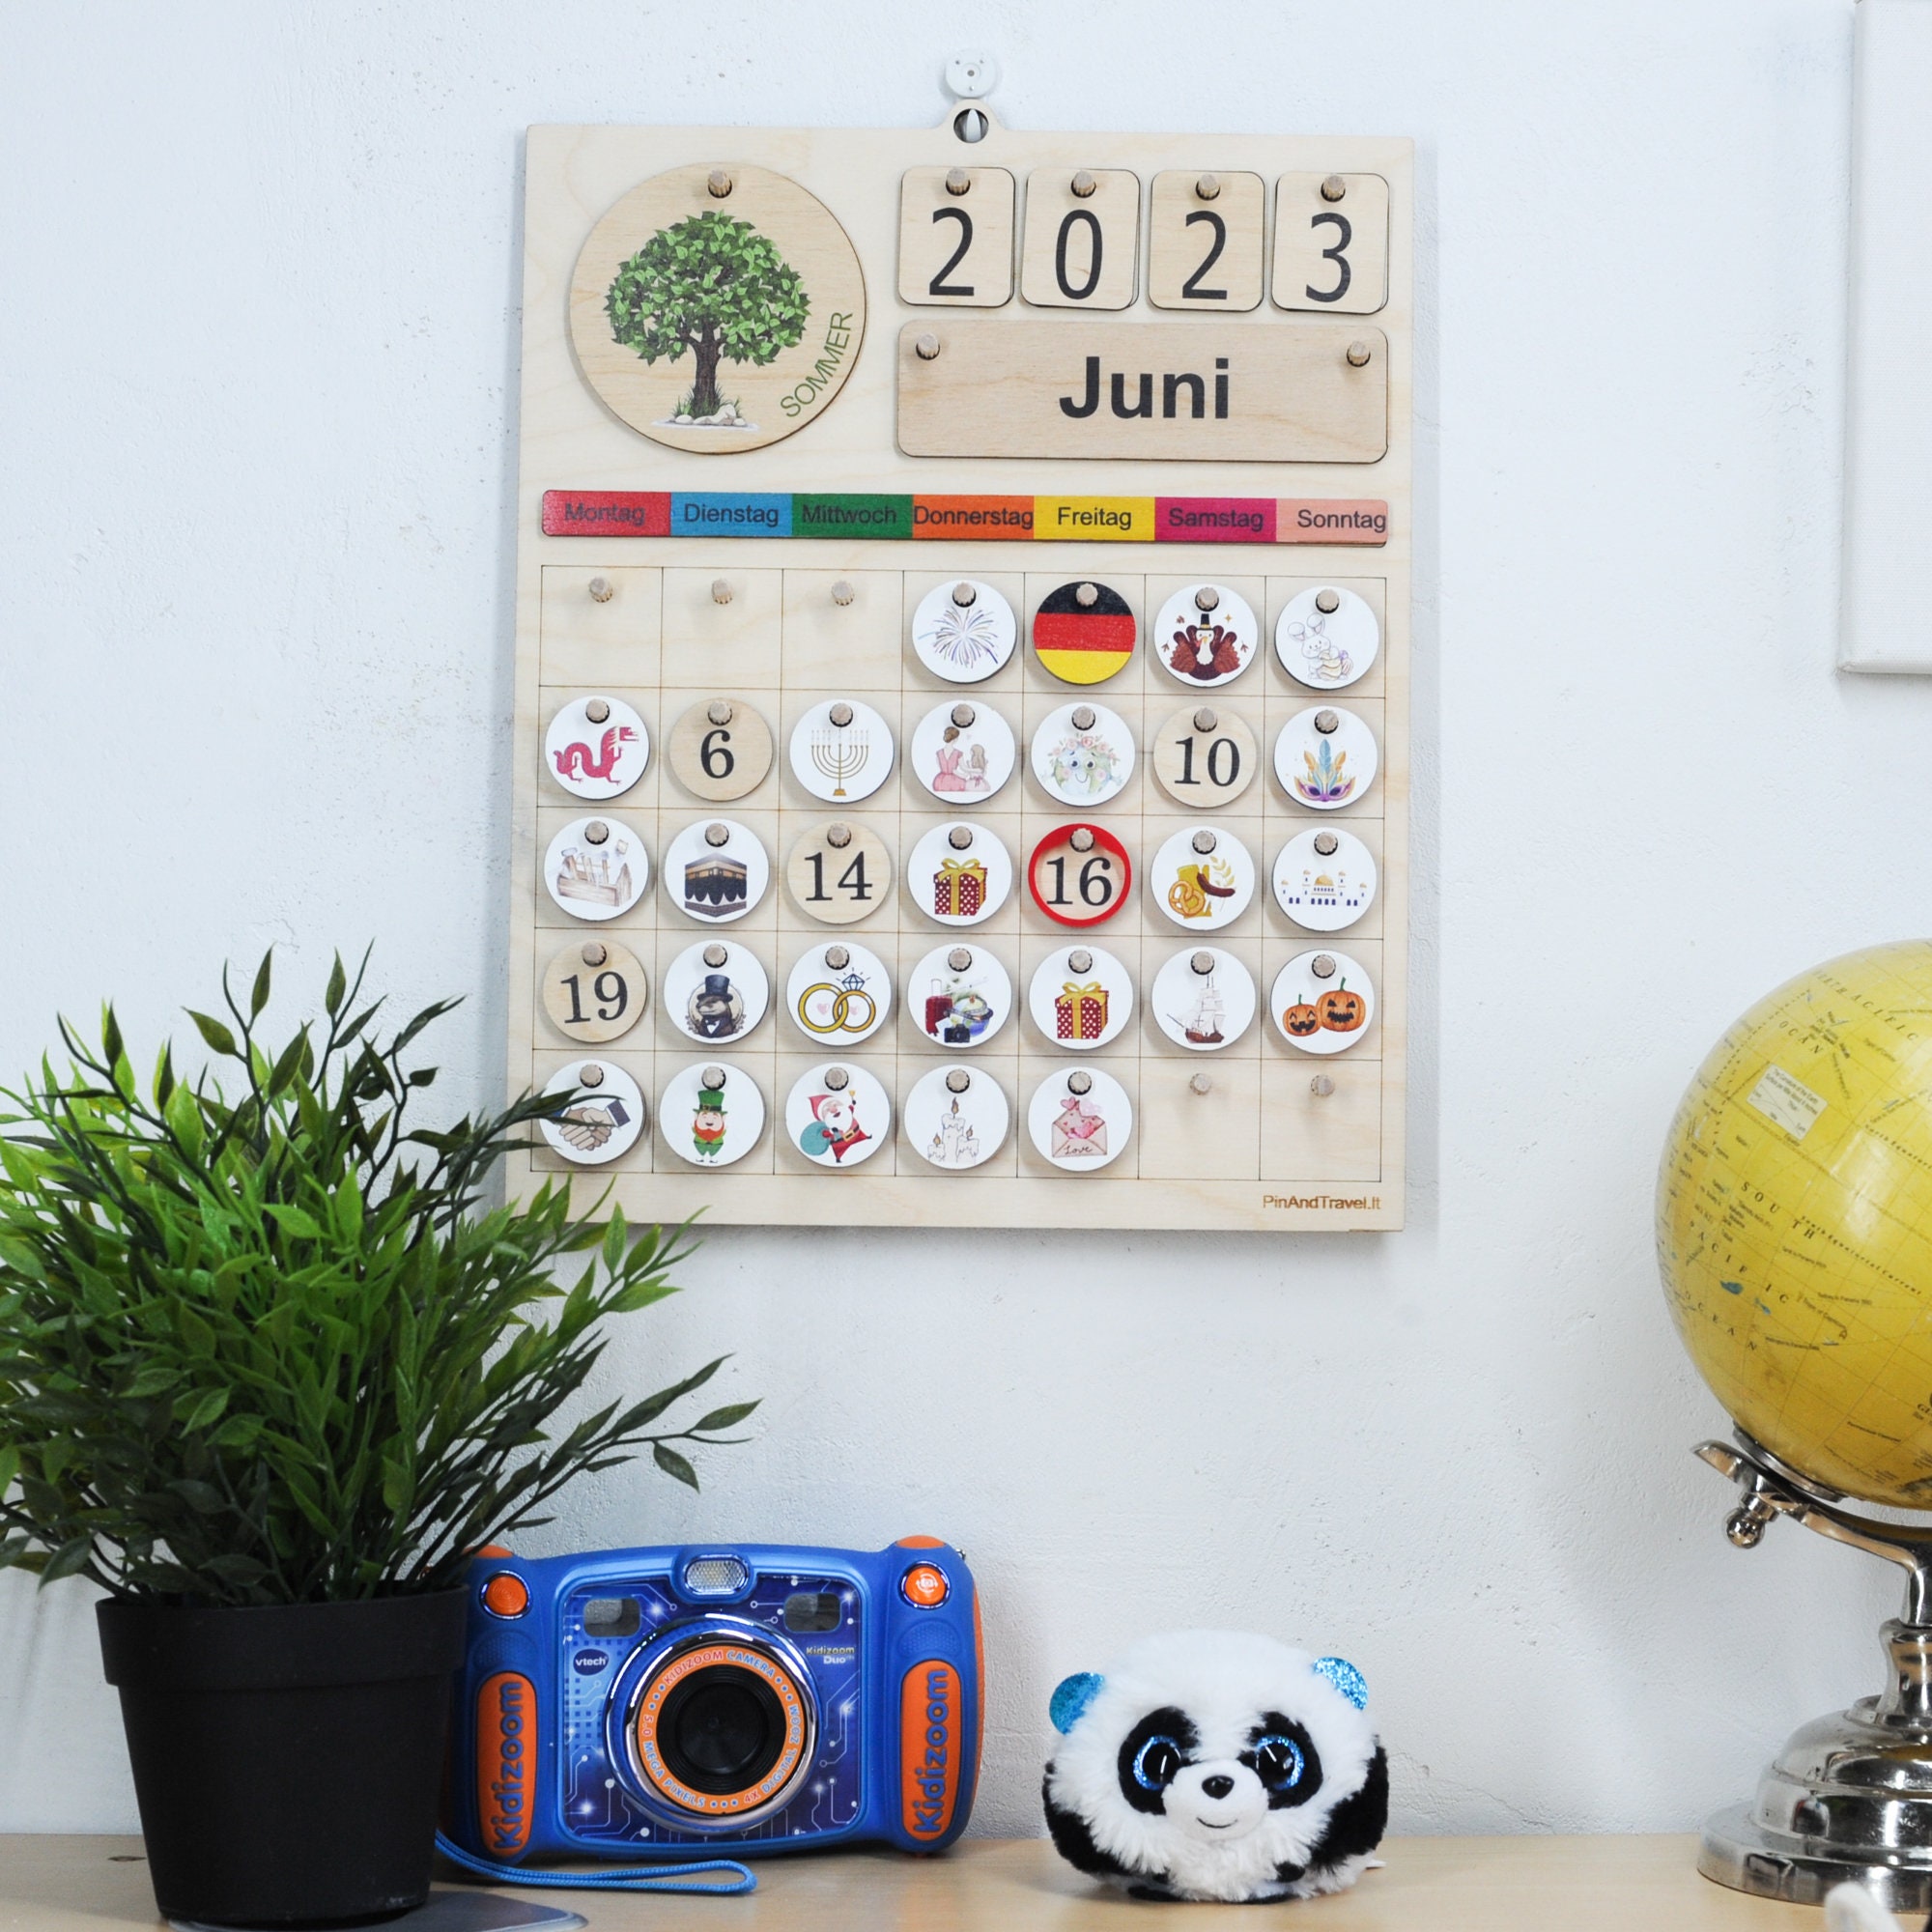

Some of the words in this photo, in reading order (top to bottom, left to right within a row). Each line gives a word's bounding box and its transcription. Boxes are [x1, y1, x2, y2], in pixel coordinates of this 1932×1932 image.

[780, 311, 854, 417] SOMMER
[1059, 355, 1230, 419] Juni
[564, 501, 646, 526] Montag
[684, 502, 780, 527] Dienstag
[802, 502, 897, 525] Mittwoch
[914, 504, 1033, 530] Donnerstag
[1057, 505, 1133, 530] Freitag
[1168, 507, 1264, 532] Samstag
[1297, 508, 1387, 533] Sonntag
[699, 728, 735, 780] 6
[1174, 736, 1240, 787] 10
[804, 850, 873, 902] 14
[1046, 855, 1113, 907] 16
[560, 970, 629, 1025] 19
[1064, 1145, 1094, 1155] Love
[575, 1656, 607, 1666] vtech
[664, 1650, 724, 1685] KIDIZOOM
[726, 1650, 776, 1678] CAMERA
[806, 1645, 855, 1655] Kidizoom
[492, 1681, 525, 1849] Kidizoom
[642, 1741, 666, 1779] MEGA
[664, 1778, 706, 1808] PIXELS
[744, 1792, 761, 1804] 4X
[761, 1747, 798, 1795] DIGITAL
[789, 1703, 802, 1745] ZOOM
[914, 1669, 950, 1833] Kidizoom
